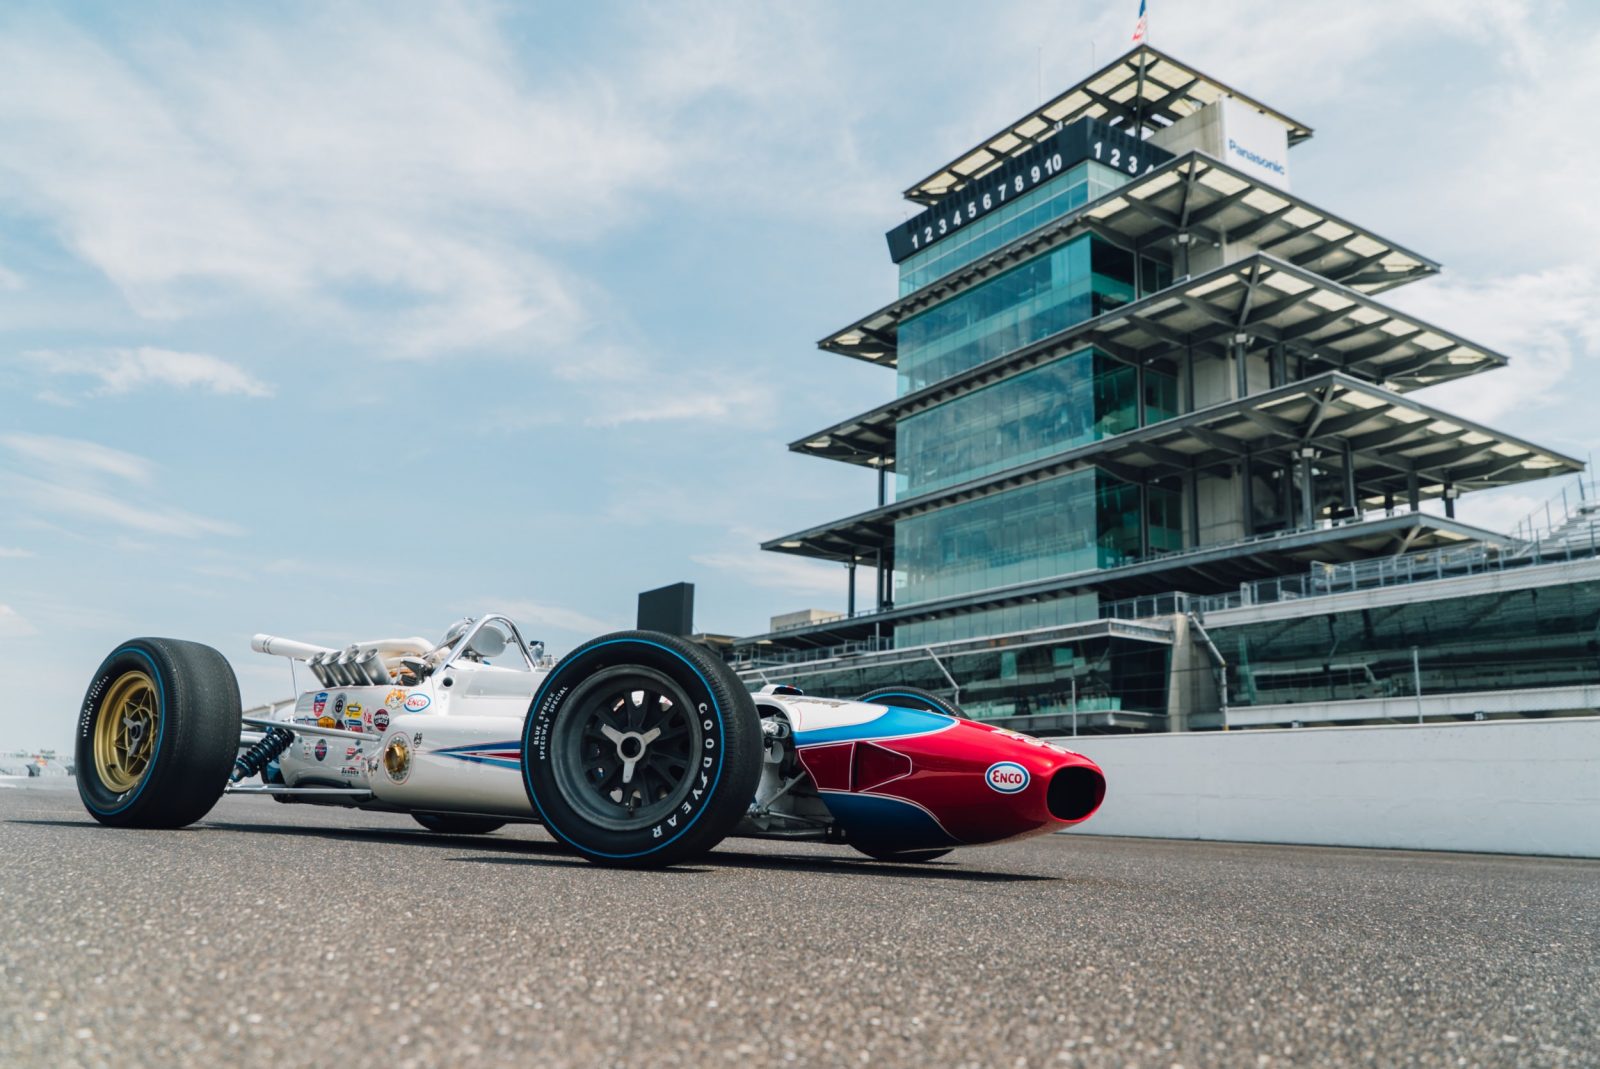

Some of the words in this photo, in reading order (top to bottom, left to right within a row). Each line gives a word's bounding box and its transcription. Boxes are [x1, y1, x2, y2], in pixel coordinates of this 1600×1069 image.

[1094, 141, 1102, 159] 1
[1110, 148, 1120, 167] 2
[1128, 155, 1137, 173] 3
[1229, 139, 1285, 175] Panasonic
[912, 234, 918, 248] 1
[924, 227, 933, 243] 2
[939, 219, 947, 234] 3
[953, 211, 961, 225] 4
[968, 202, 976, 218] 5
[983, 193, 991, 210] 6
[998, 184, 1007, 201] 7
[1014, 175, 1024, 192] 8
[1031, 166, 1040, 183] 9
[1045, 153, 1062, 174] 10
[407, 697, 427, 707] ENCO
[533, 725, 541, 745] BLUE
[538, 692, 555, 720] STREAK
[539, 717, 550, 760] SPEEDWAY
[549, 686, 568, 713] SPECIAL
[652, 702, 714, 839] GOODYEAR
[992, 769, 1023, 784] ENCO
